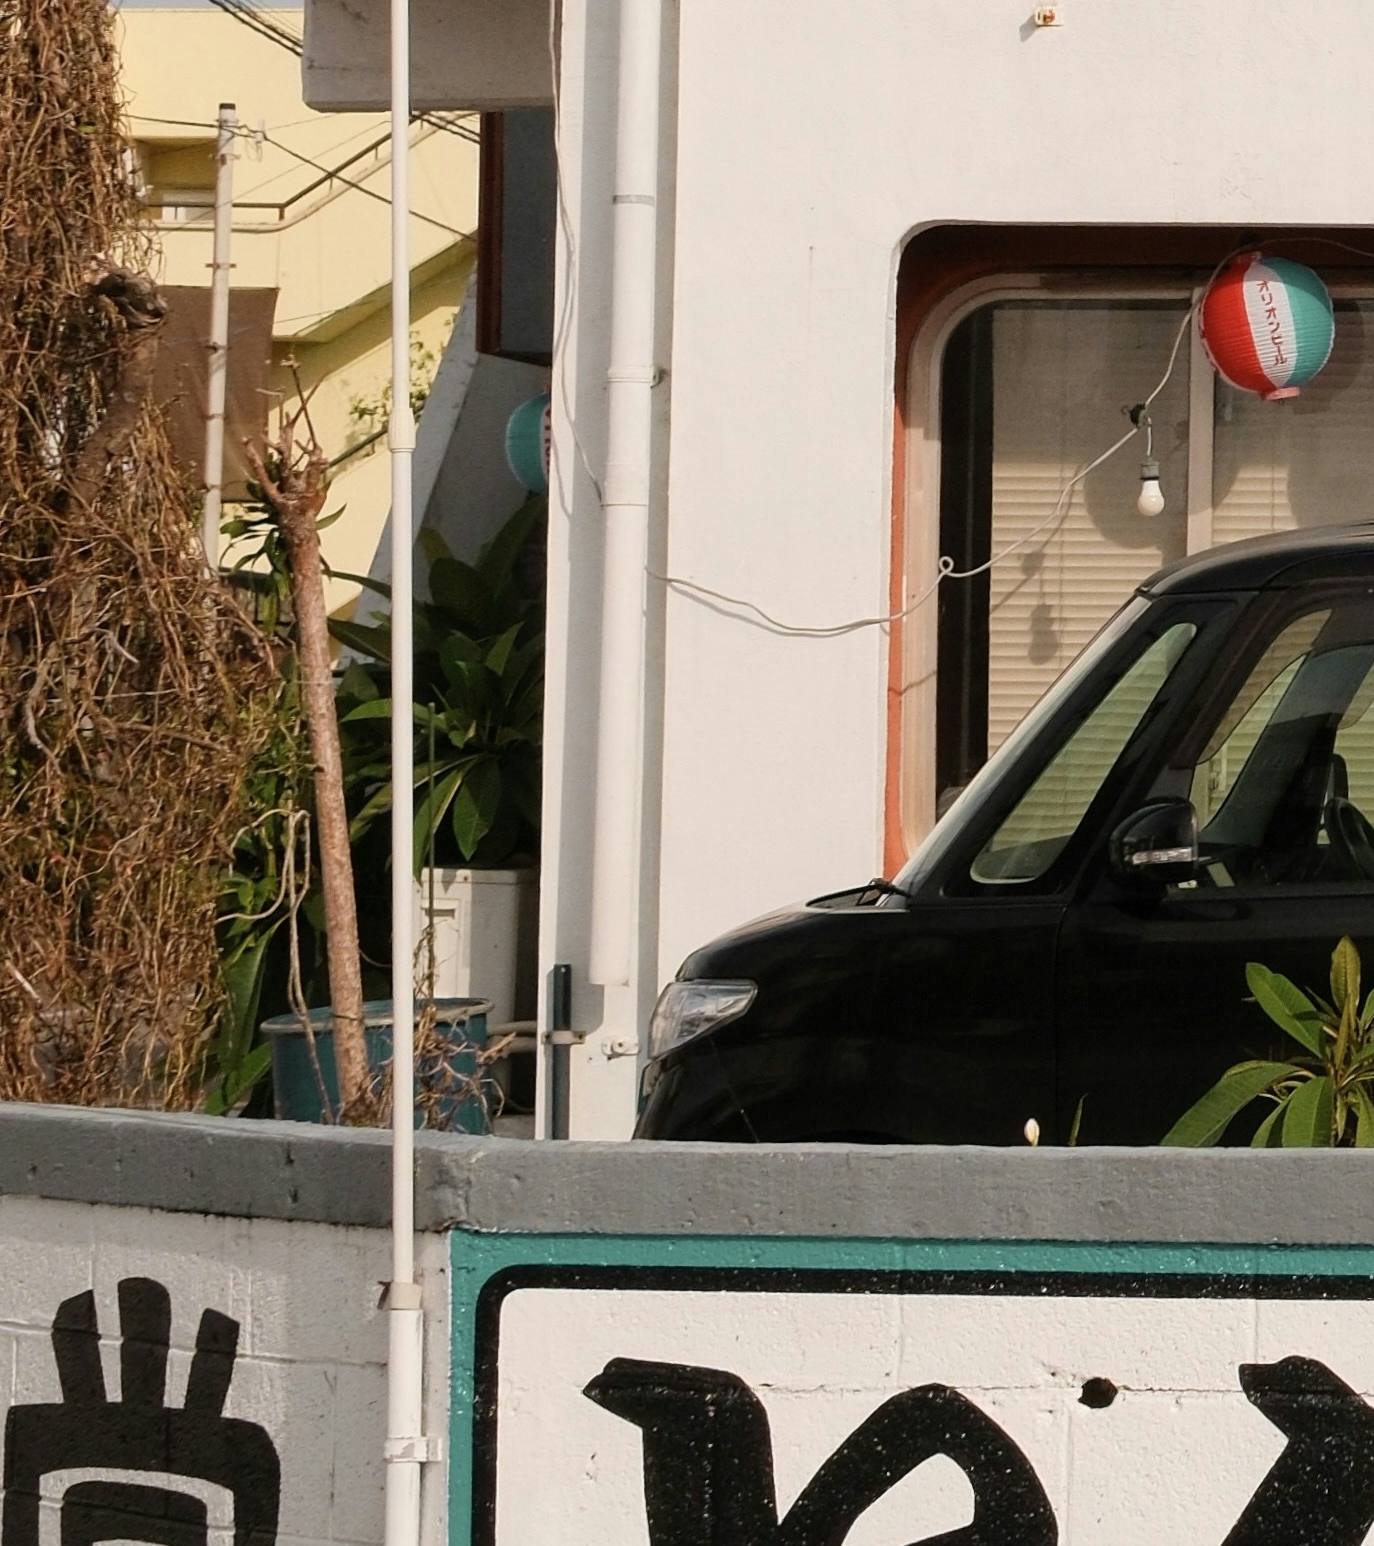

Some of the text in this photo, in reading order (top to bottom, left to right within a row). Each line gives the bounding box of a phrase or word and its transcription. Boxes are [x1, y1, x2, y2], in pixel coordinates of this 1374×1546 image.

[1256, 280, 1288, 366] オリオンビール
